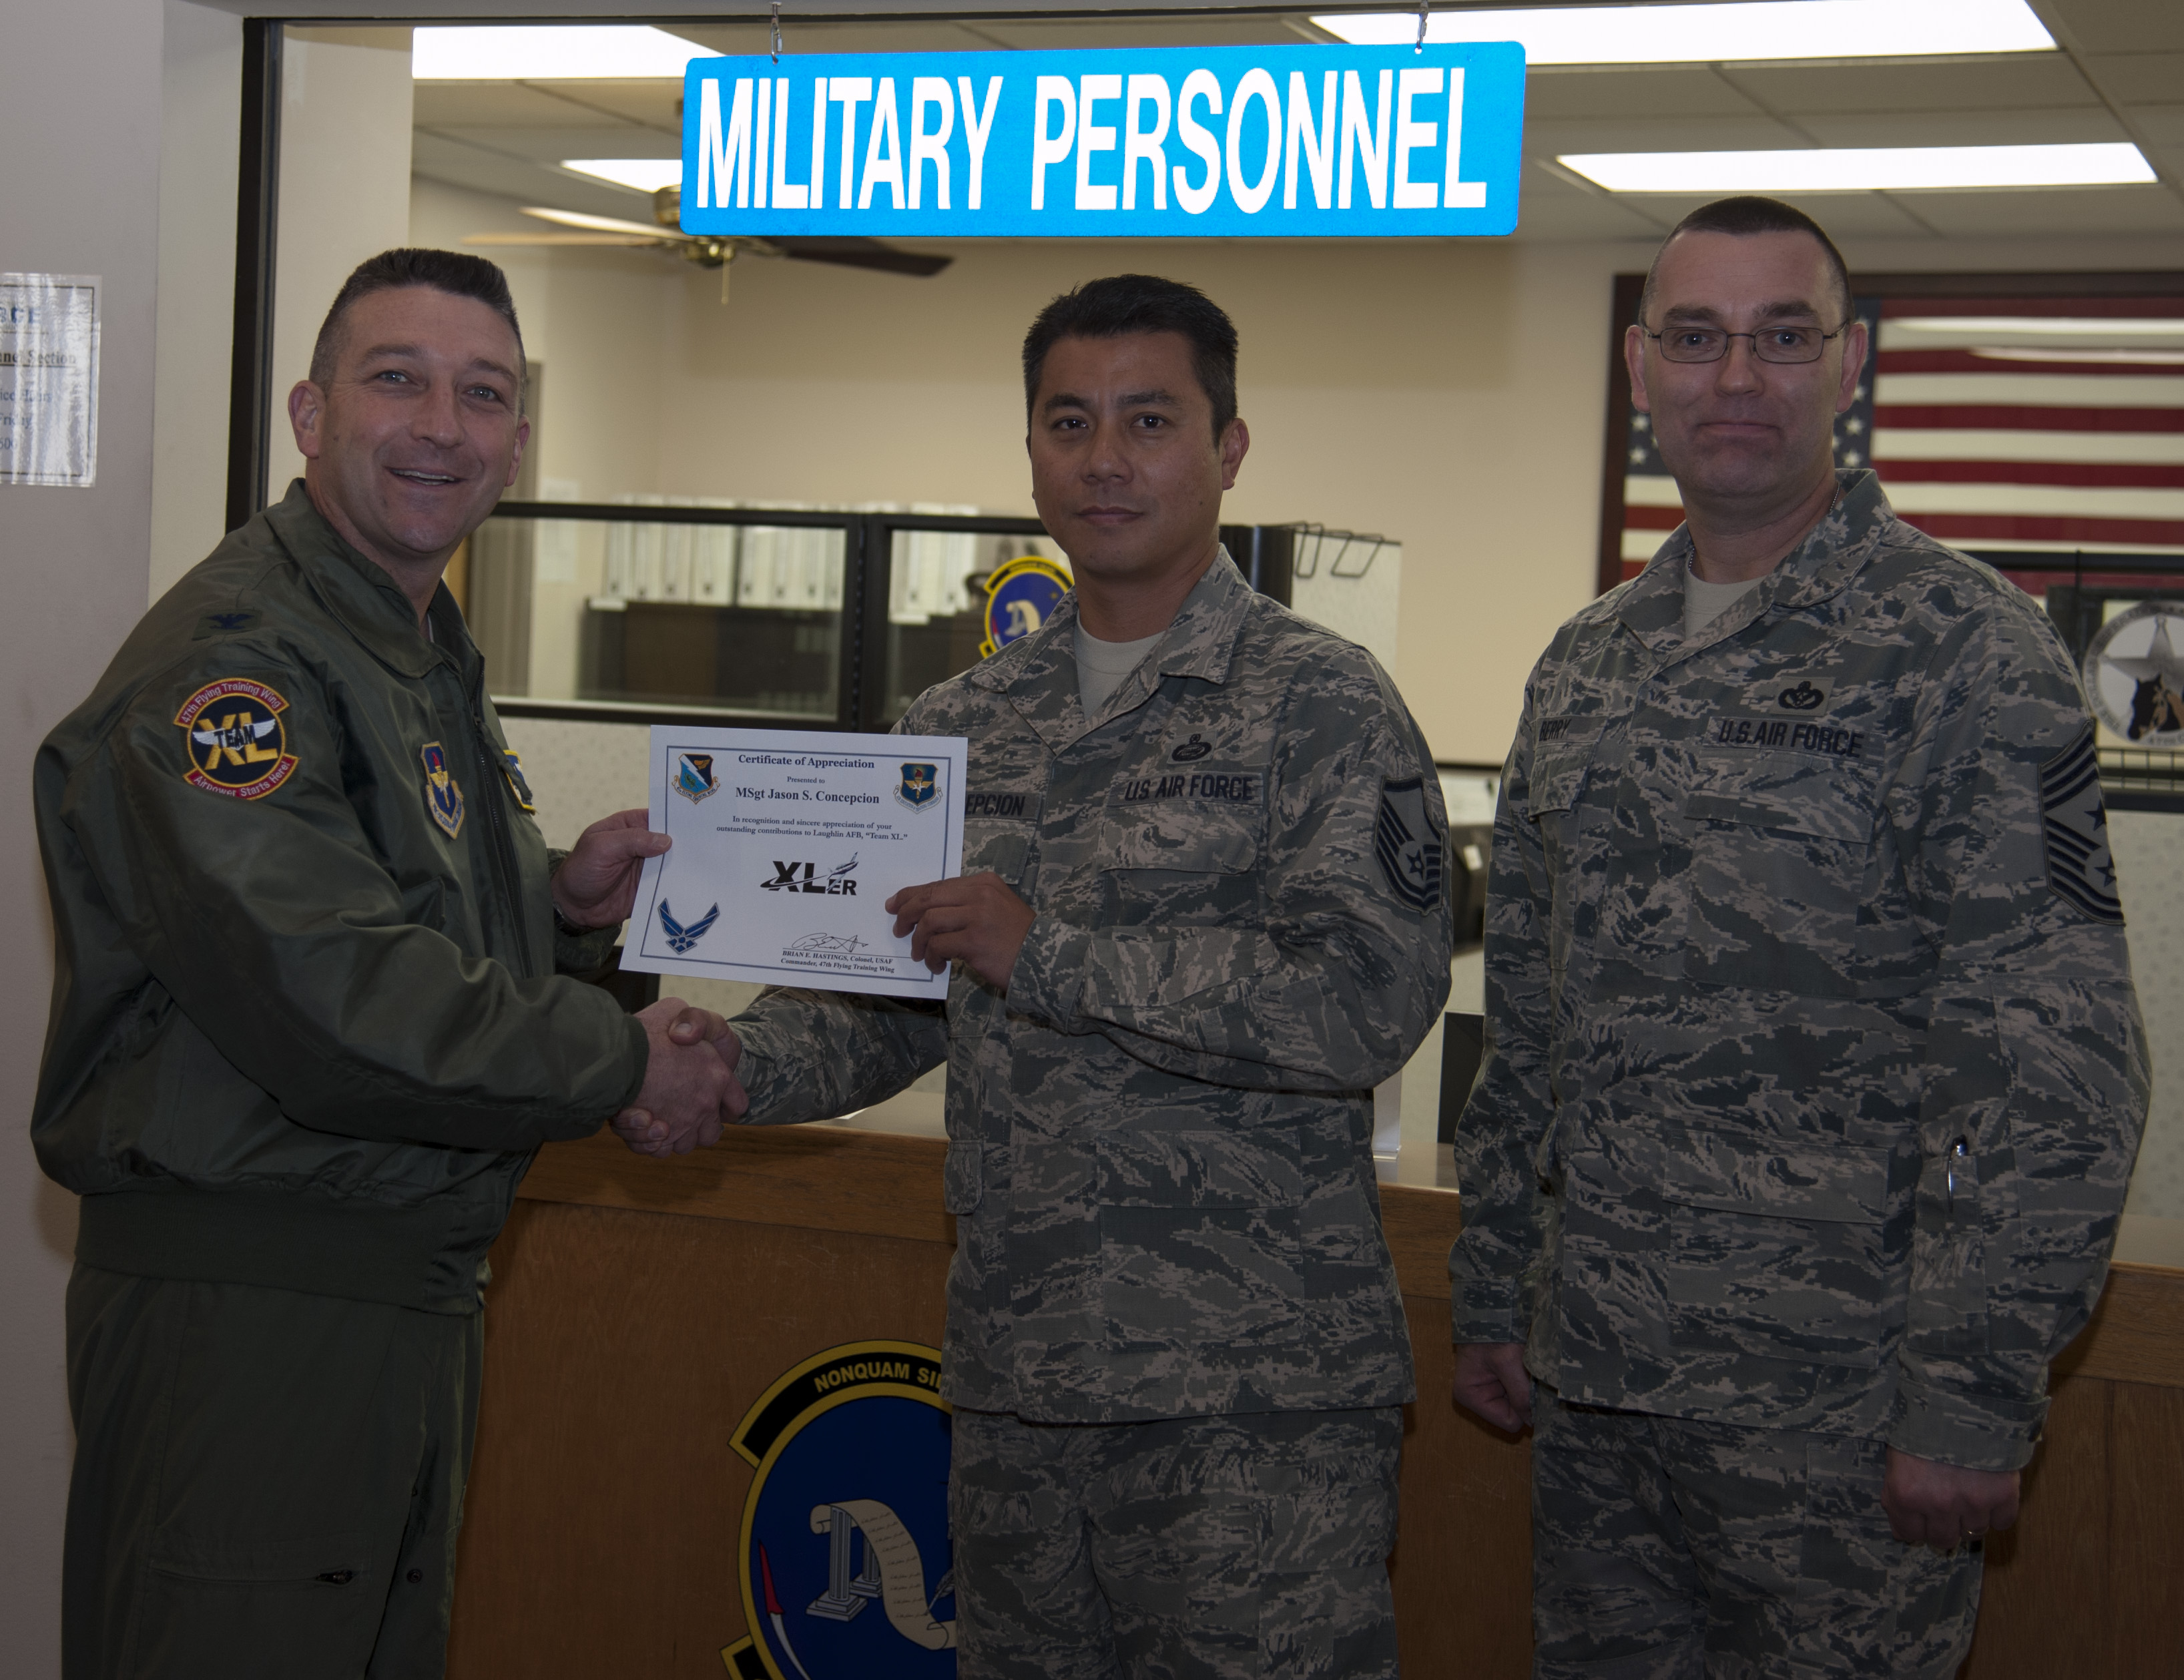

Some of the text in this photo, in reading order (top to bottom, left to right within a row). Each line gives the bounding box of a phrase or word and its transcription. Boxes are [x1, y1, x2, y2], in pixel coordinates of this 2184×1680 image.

[696, 66, 1487, 215] MILITARY PERSONNEL
[181, 681, 282, 724] 47th Flying Training Wing
[214, 724, 256, 749] TEAM
[1539, 718, 1572, 742] BERRY
[1753, 720, 1788, 746] AIR
[1790, 724, 1865, 758] FORCE
[738, 754, 874, 768] Certificate of Appreciation
[240, 782, 270, 798] Starts
[269, 761, 291, 784] Here!
[1155, 775, 1186, 799] AIR
[1189, 774, 1254, 800] FORCE
[735, 787, 879, 805] MSgt Jason S. Concepcion
[716, 826, 756, 834] outstanding
[758, 828, 802, 836] contributions
[813, 830, 844, 838] Laughlin
[845, 831, 864, 839] AFB,
[822, 821, 864, 829] appreciation
[780, 958, 818, 966] Commander,
[853, 964, 878, 972] Training
[813, 952, 849, 962] HASTINGS,
[850, 955, 874, 963] Colonel,
[813, 1361, 910, 1393] NONQUAM
